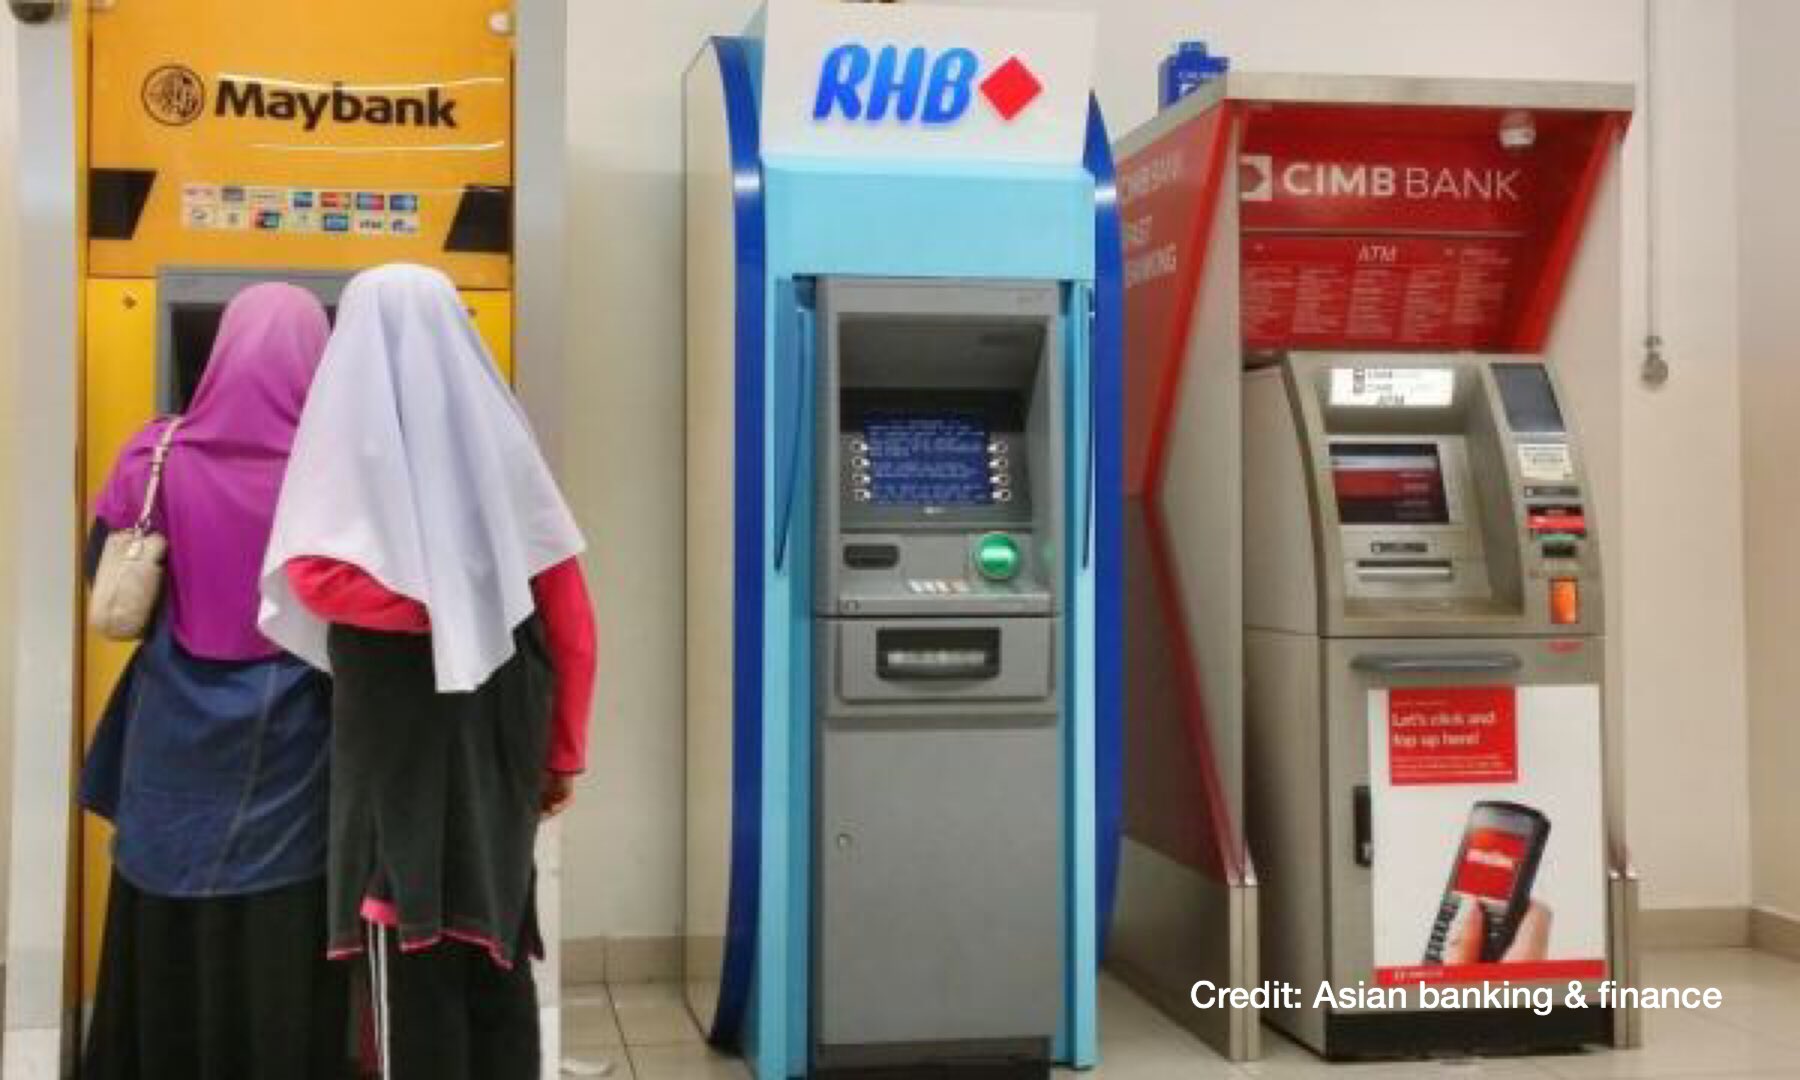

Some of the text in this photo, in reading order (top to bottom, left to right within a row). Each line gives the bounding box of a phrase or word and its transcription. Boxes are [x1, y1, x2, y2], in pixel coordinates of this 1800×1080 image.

[812, 44, 979, 124] RHB
[214, 80, 457, 131] Maybank
[1282, 162, 1521, 201] CIMB BANK
[1357, 244, 1398, 263] ATM
[1391, 712, 1427, 727] Let's
[1466, 710, 1498, 727] and
